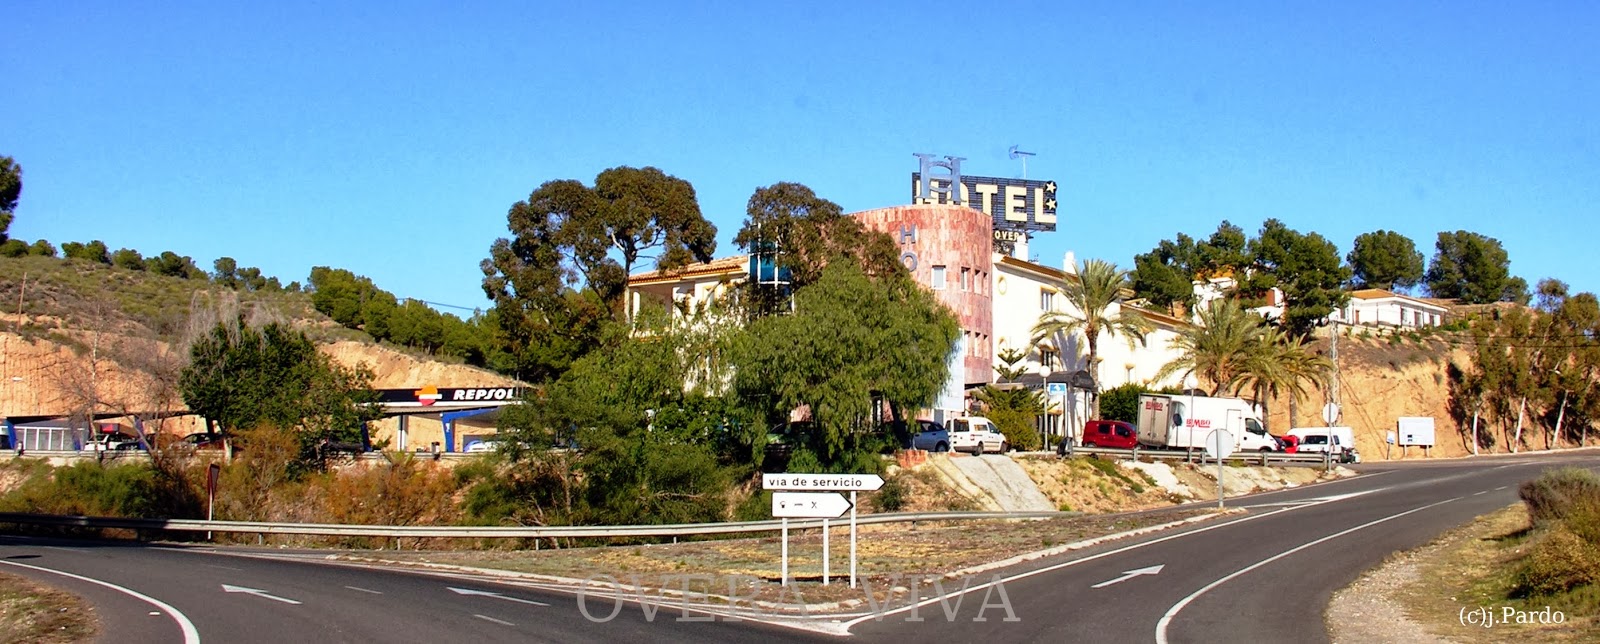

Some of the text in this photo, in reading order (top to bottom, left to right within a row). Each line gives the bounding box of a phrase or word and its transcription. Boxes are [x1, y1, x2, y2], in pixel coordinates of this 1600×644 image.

[994, 230, 1026, 241] OVER
[454, 389, 513, 400] REPSOL
[792, 477, 808, 487] de
[812, 477, 862, 487] servicio
